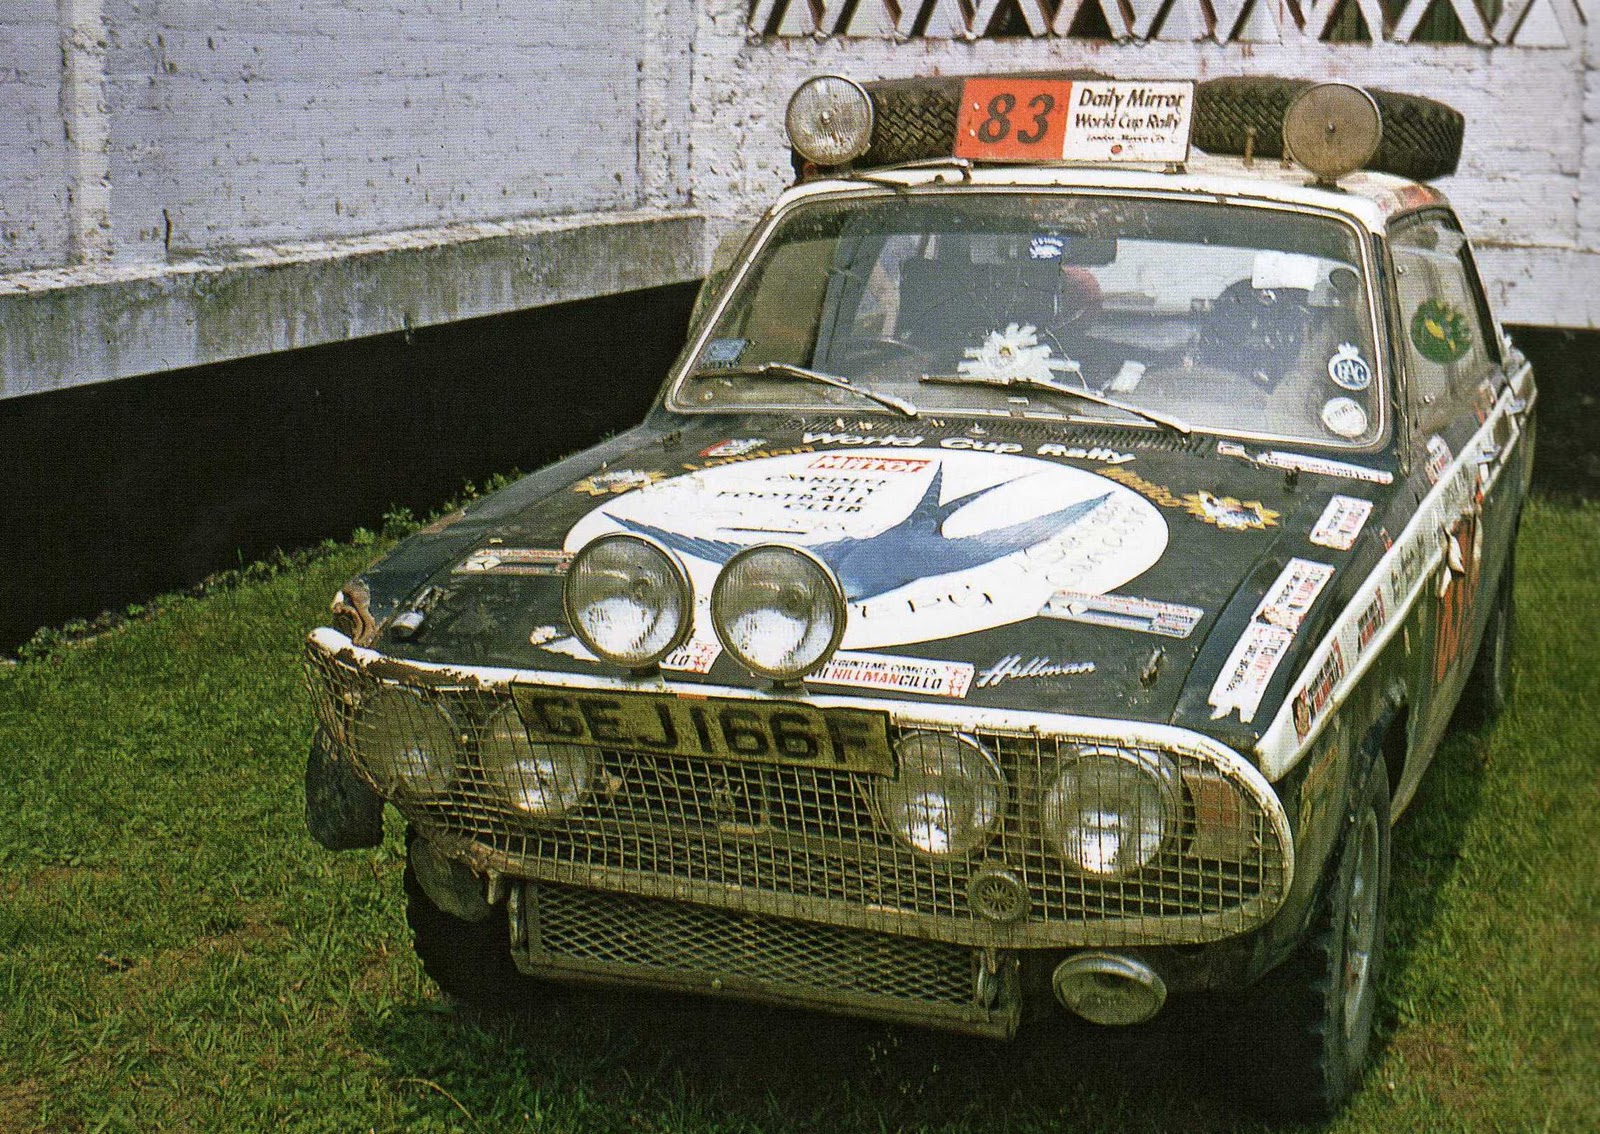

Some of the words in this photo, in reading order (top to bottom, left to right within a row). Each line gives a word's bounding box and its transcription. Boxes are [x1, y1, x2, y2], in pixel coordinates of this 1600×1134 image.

[1079, 87, 1124, 112] Daily
[1127, 88, 1184, 114] Mirror
[978, 93, 1055, 144] 83
[1075, 113, 1117, 129] World
[1118, 112, 1144, 132] Cup
[1147, 113, 1181, 133] Rally
[802, 432, 925, 447] World
[940, 436, 1024, 454] Cup
[1036, 443, 1136, 465] Rally
[831, 669, 943, 690] HILLMANCILLO
[976, 653, 1097, 689] Hillman
